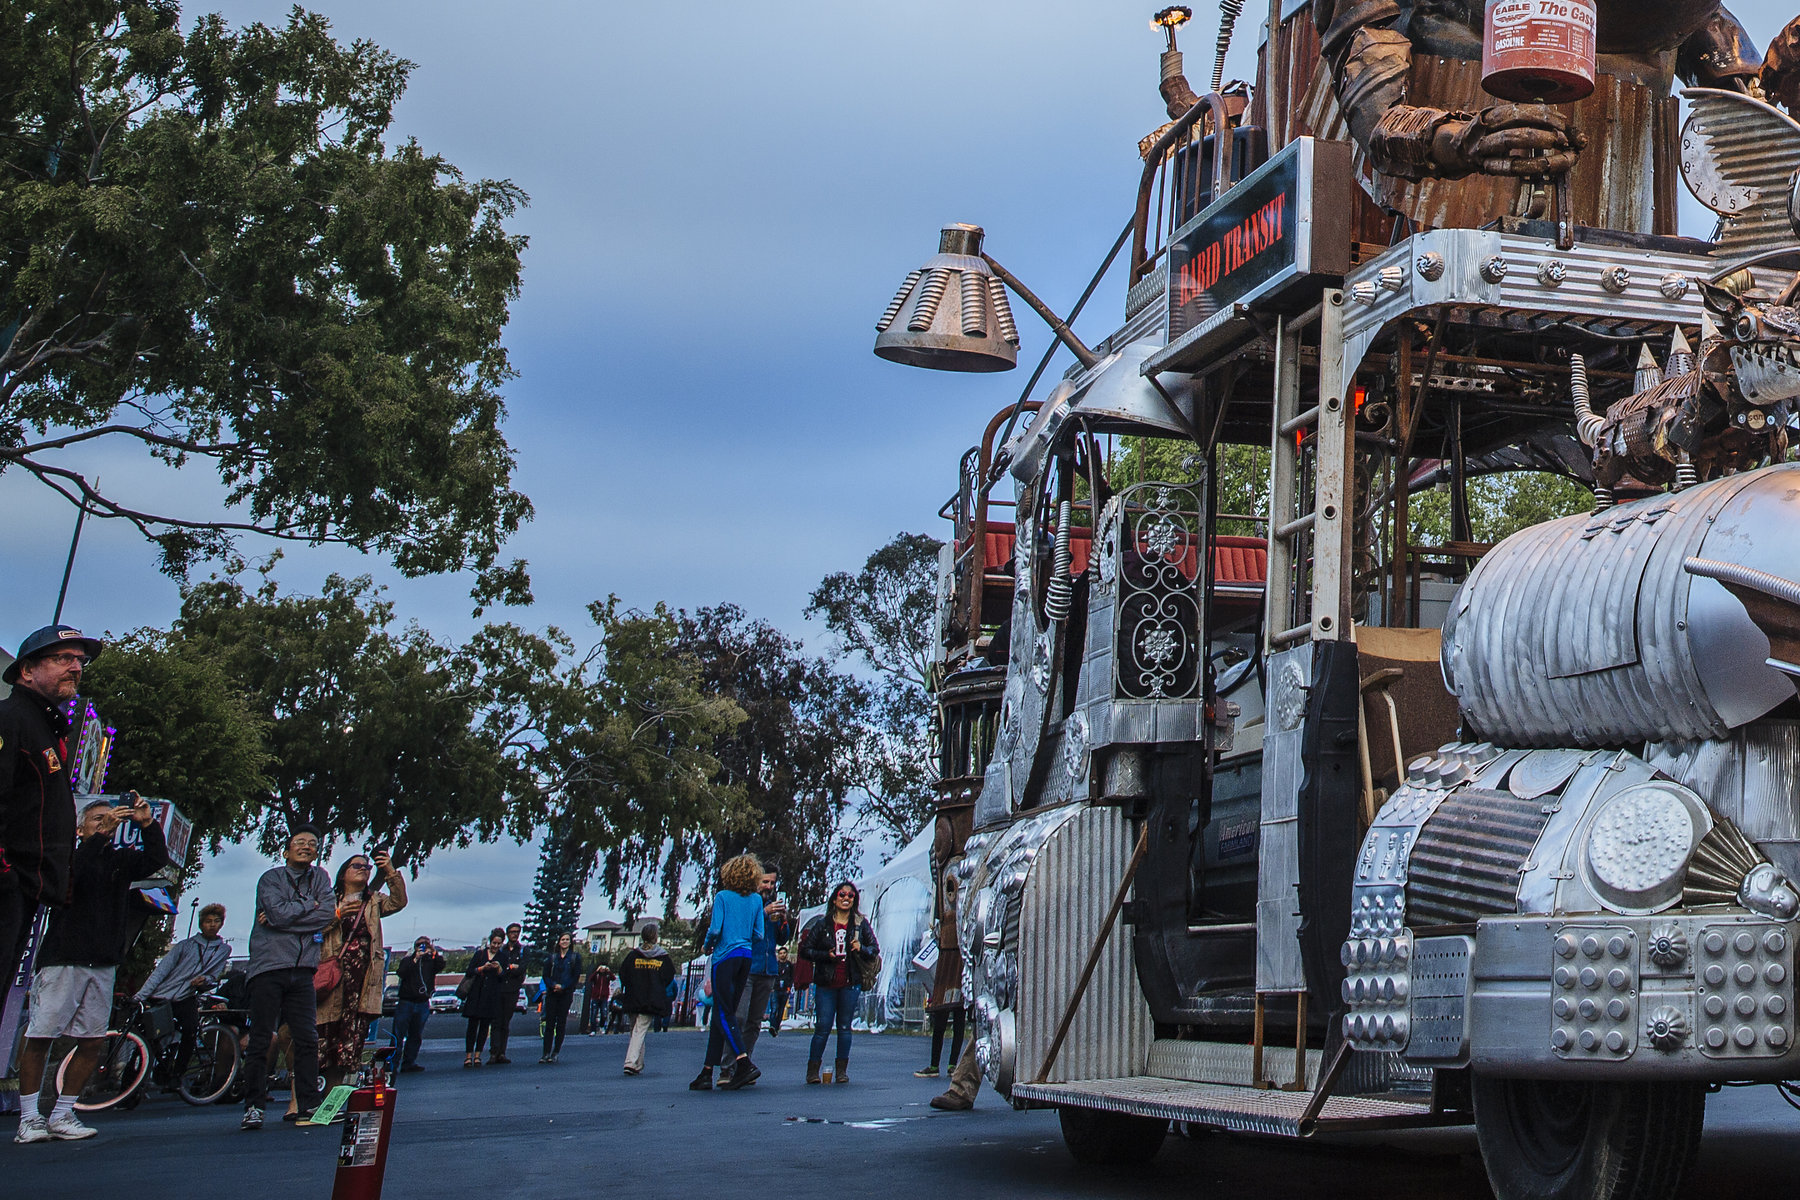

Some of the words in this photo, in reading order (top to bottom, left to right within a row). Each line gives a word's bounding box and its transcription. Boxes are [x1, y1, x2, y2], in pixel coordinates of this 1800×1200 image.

[1495, 3, 1530, 16] EAGLE
[1539, 1, 1568, 17] The
[1495, 35, 1525, 51] GASOLINE
[1683, 139, 1691, 150] 9
[1683, 161, 1691, 174] 8
[1694, 183, 1701, 194] 7
[1743, 189, 1752, 200] 4
[1710, 196, 1718, 207] 6
[1729, 198, 1736, 210] 5
[1179, 240, 1221, 307] RABID
[1223, 191, 1286, 277] TRANSIT
